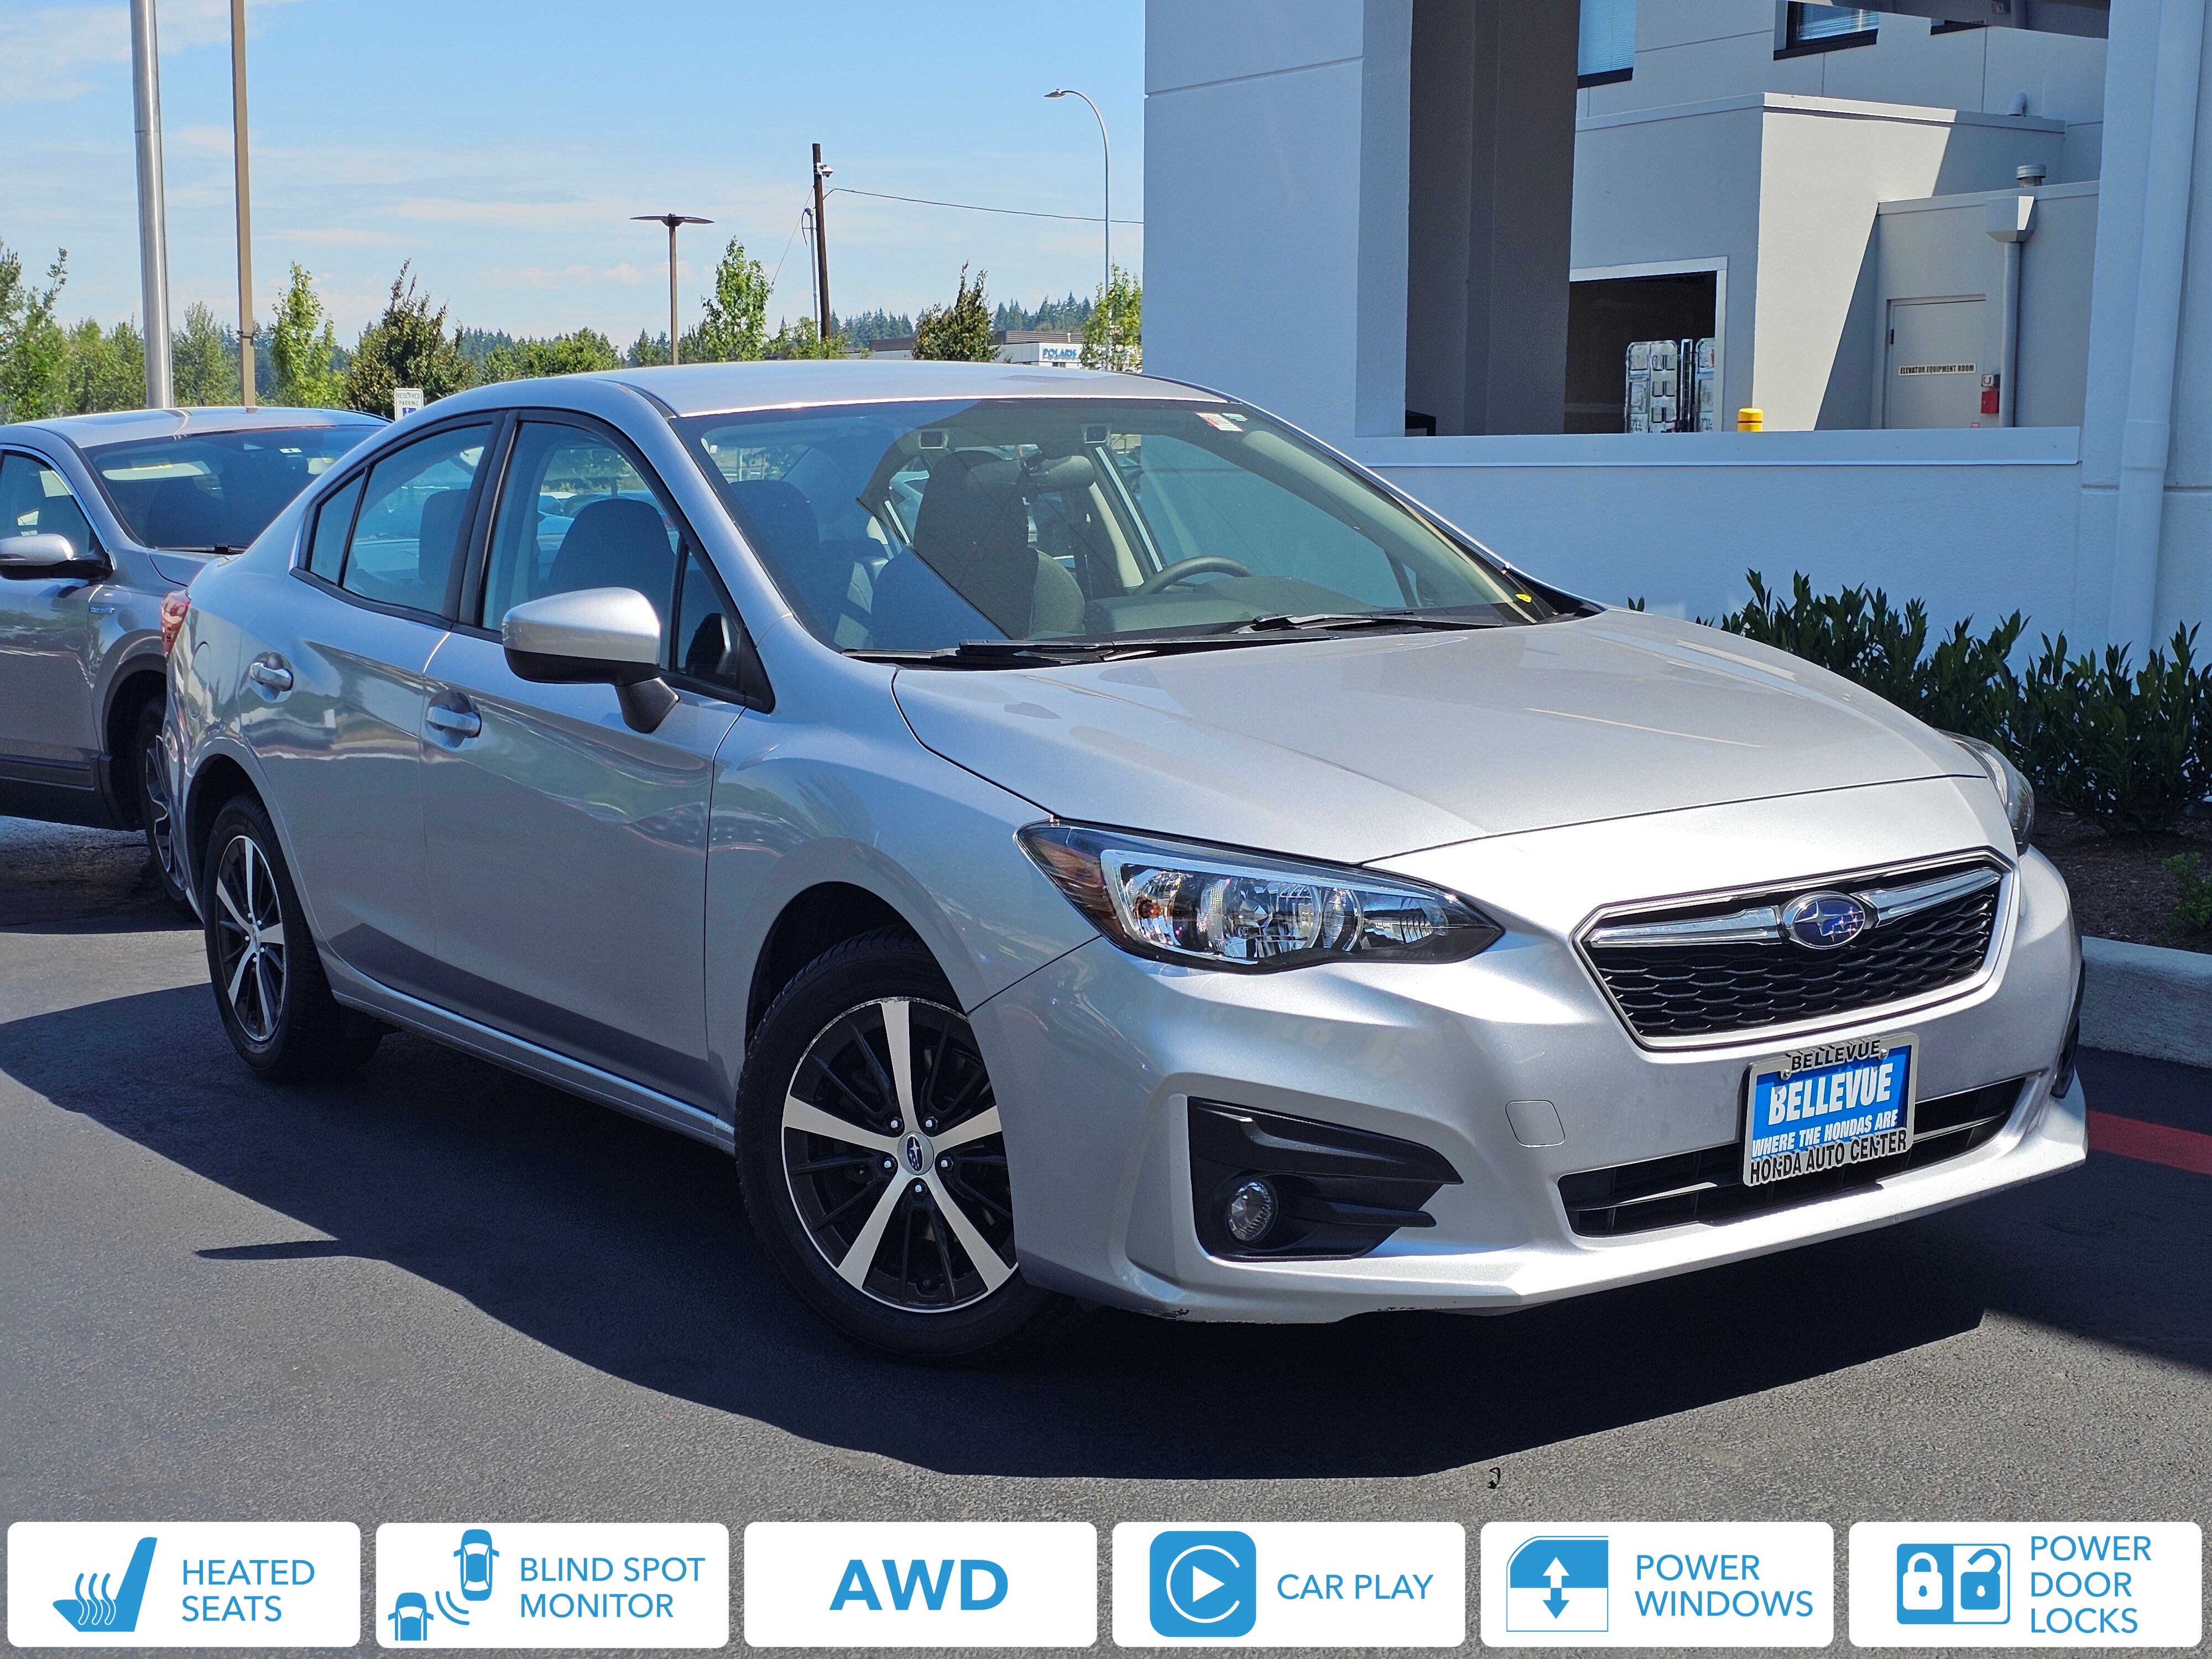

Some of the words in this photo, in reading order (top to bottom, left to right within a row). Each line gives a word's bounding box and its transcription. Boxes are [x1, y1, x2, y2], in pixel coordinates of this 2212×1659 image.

[1044, 348, 1077, 358] POLARIS
[1926, 365, 1955, 373] EQUIPMENT
[1791, 1040, 1881, 1071] BELLEVUE
[1768, 1063, 1893, 1125] BELLEVUE
[1752, 1134, 1796, 1157] WHERE
[1799, 1128, 1820, 1146] THE
[1824, 1114, 1872, 1141] HONDAS
[1875, 1109, 1899, 1130] ARE
[1750, 1155, 1802, 1185] HONDA
[1806, 1142, 1845, 1171] AUTO
[1850, 1130, 1907, 1159] CENTER
